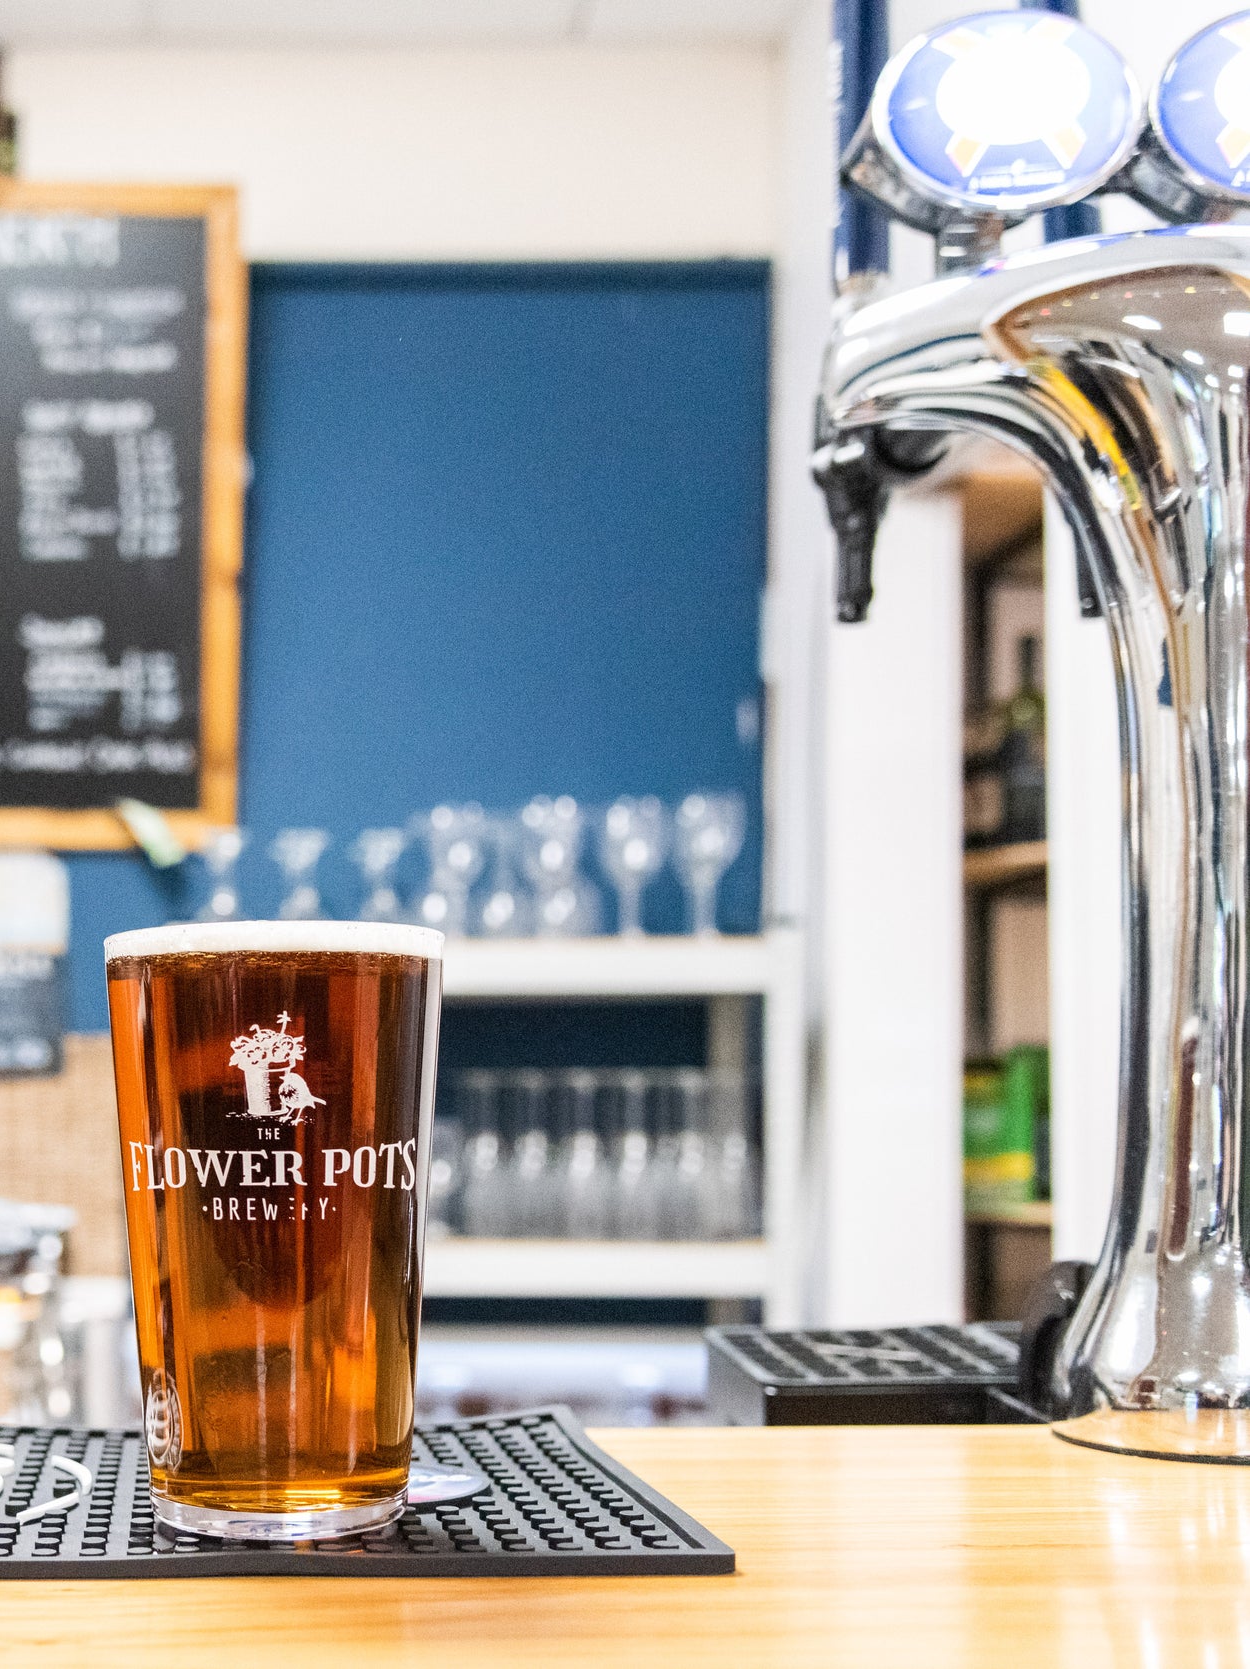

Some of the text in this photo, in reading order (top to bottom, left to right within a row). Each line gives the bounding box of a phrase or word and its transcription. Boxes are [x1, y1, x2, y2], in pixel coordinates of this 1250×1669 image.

[257, 1127, 281, 1141] THE
[128, 1137, 417, 1191] FLOWER POTS
